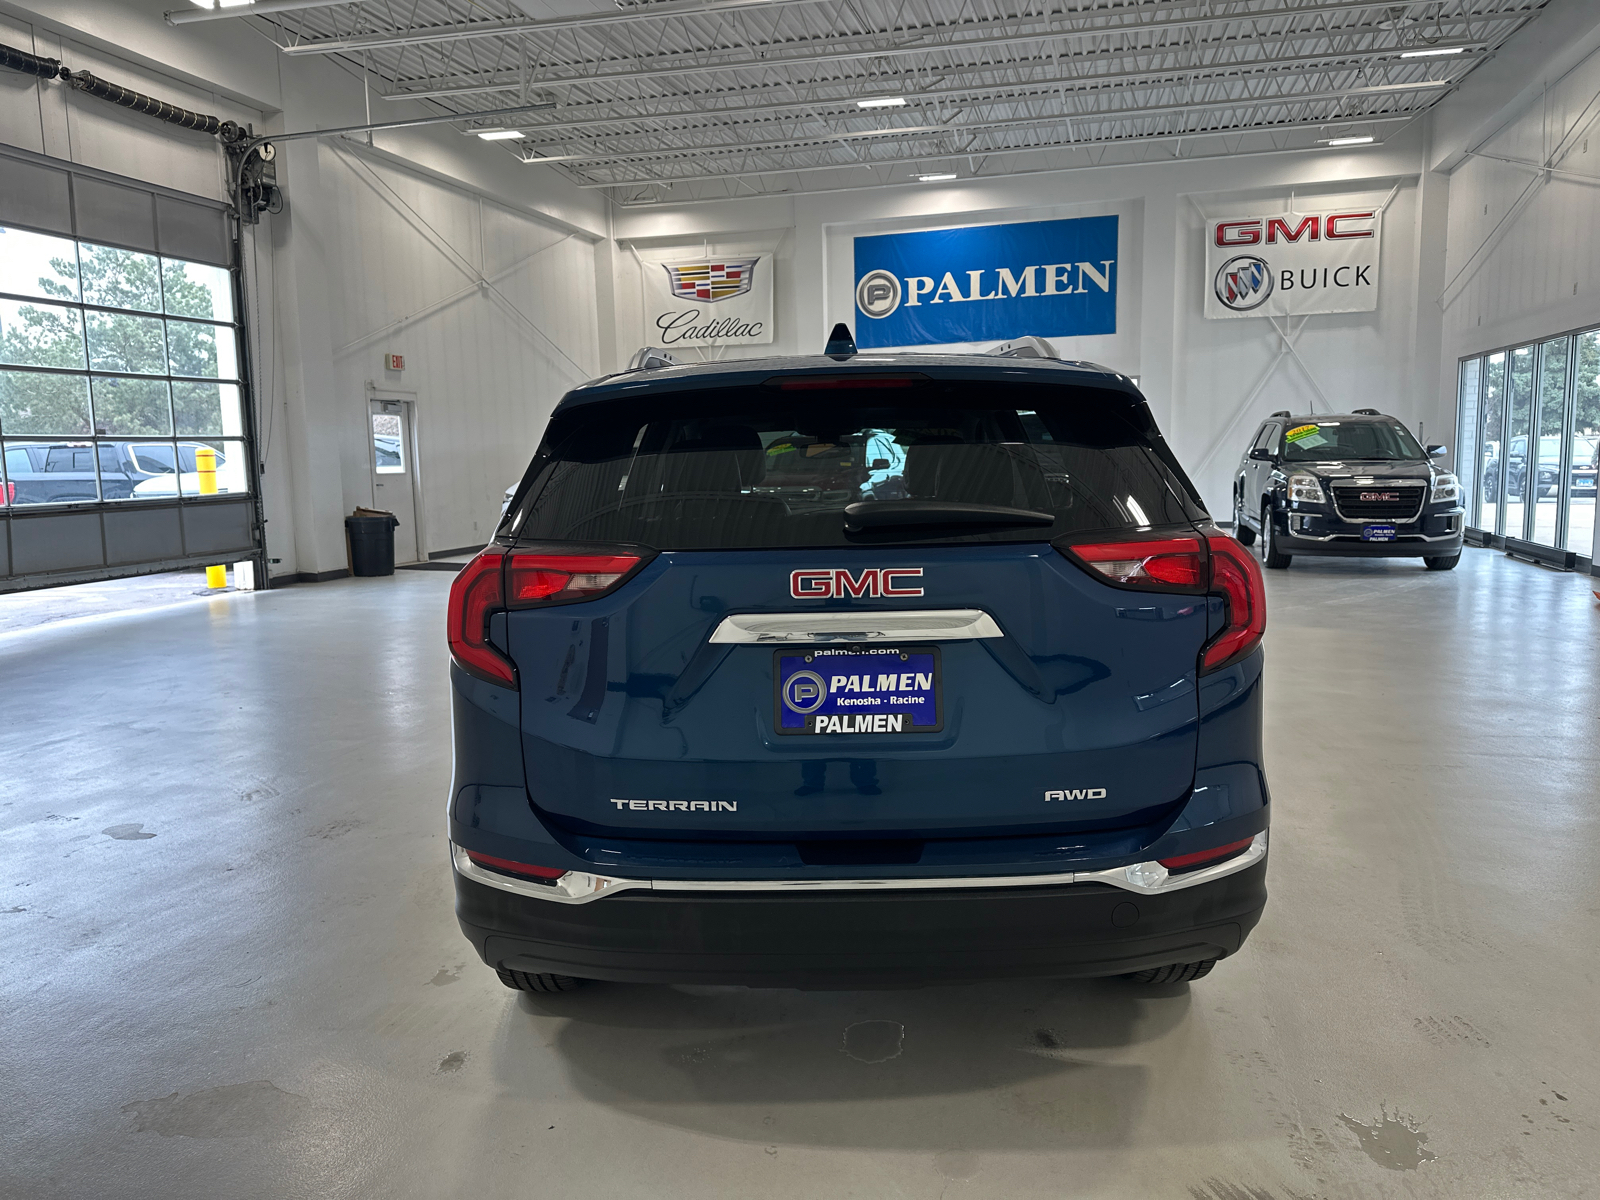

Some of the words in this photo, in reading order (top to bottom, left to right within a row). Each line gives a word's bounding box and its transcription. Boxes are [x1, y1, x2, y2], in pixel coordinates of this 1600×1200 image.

[1214, 211, 1375, 248] GMC
[904, 260, 1115, 306] PALMEN
[1280, 265, 1371, 290] BUICK
[656, 309, 763, 344] Cadillac
[392, 354, 403, 369] EXIT
[1360, 492, 1400, 501] GMC
[790, 567, 924, 599] GMC
[829, 672, 933, 693] PALMEN
[836, 697, 881, 706] Kenosha
[890, 695, 925, 705] Racine
[814, 714, 903, 734] PALMEN
[610, 798, 738, 812] TERRAIN
[1044, 788, 1107, 802] AWD
